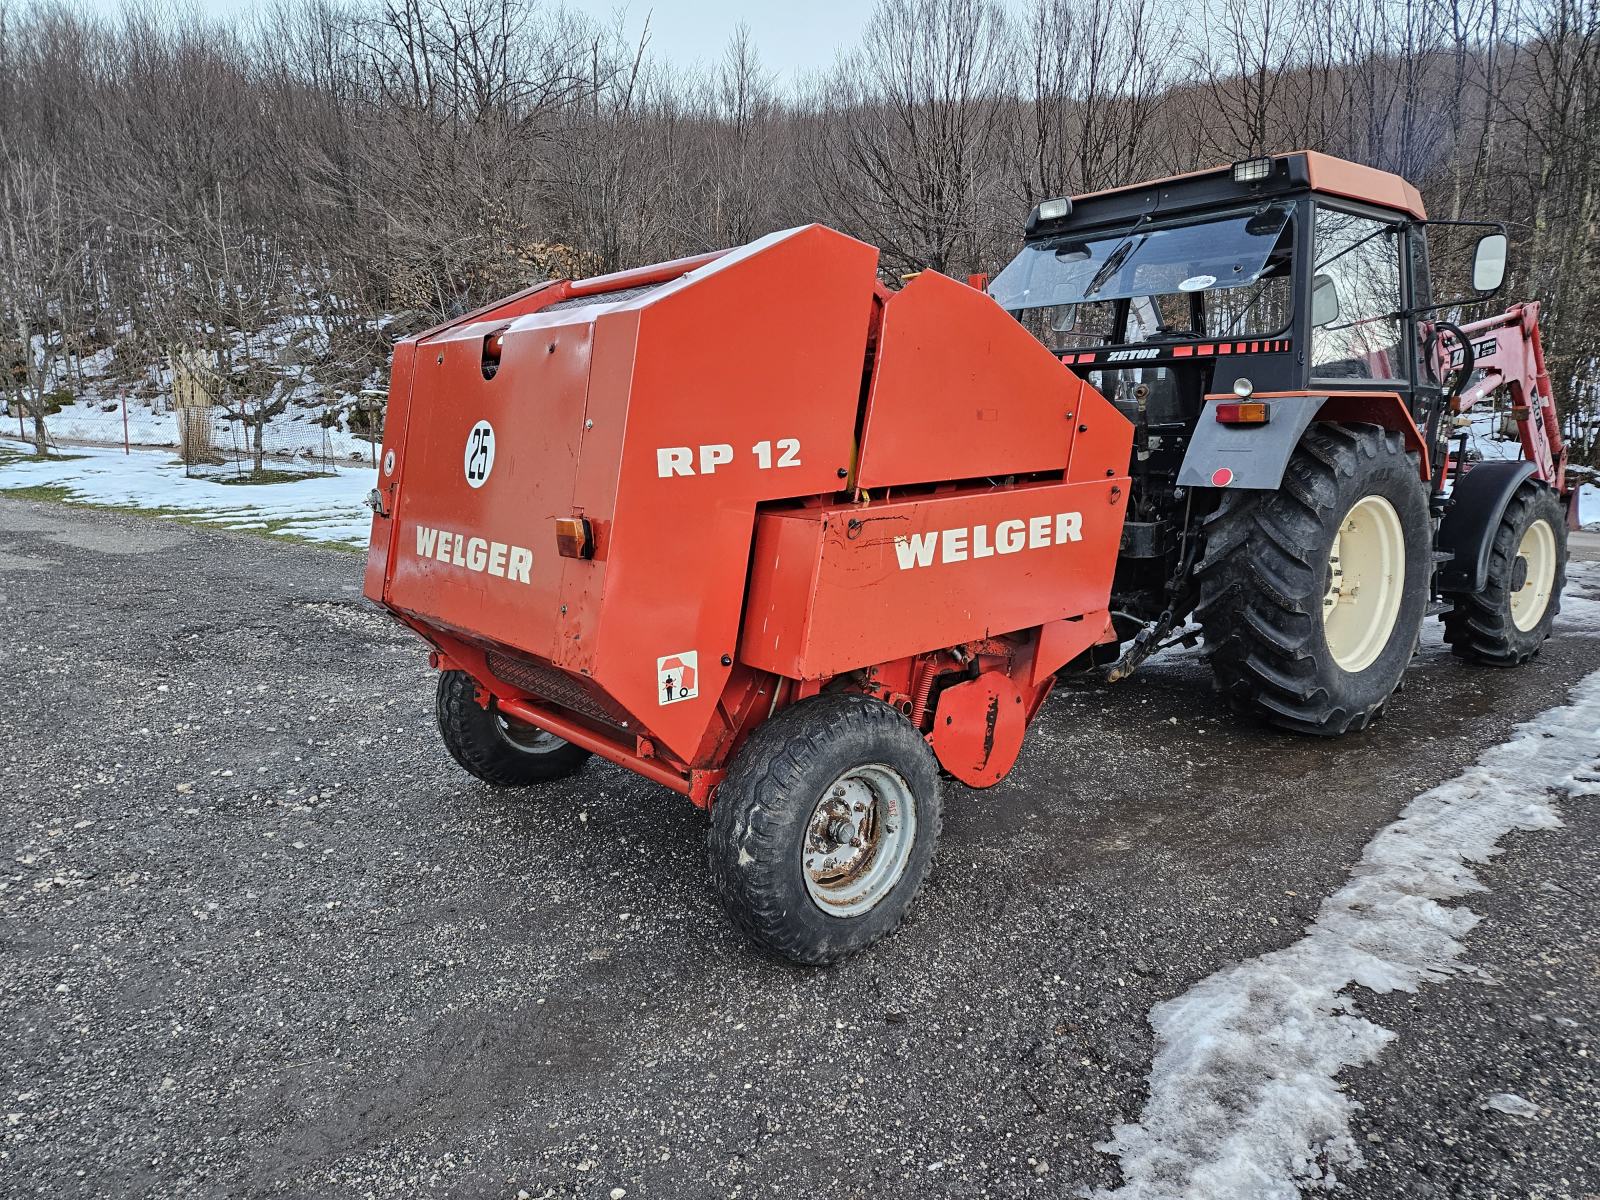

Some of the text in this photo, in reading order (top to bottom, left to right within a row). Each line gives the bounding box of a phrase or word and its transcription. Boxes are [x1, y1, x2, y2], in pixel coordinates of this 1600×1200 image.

[1107, 348, 1160, 362] ZETOR
[468, 428, 491, 480] 25
[656, 438, 801, 478] RP 12
[416, 525, 533, 585] WELGER
[894, 511, 1083, 571] WELGER
